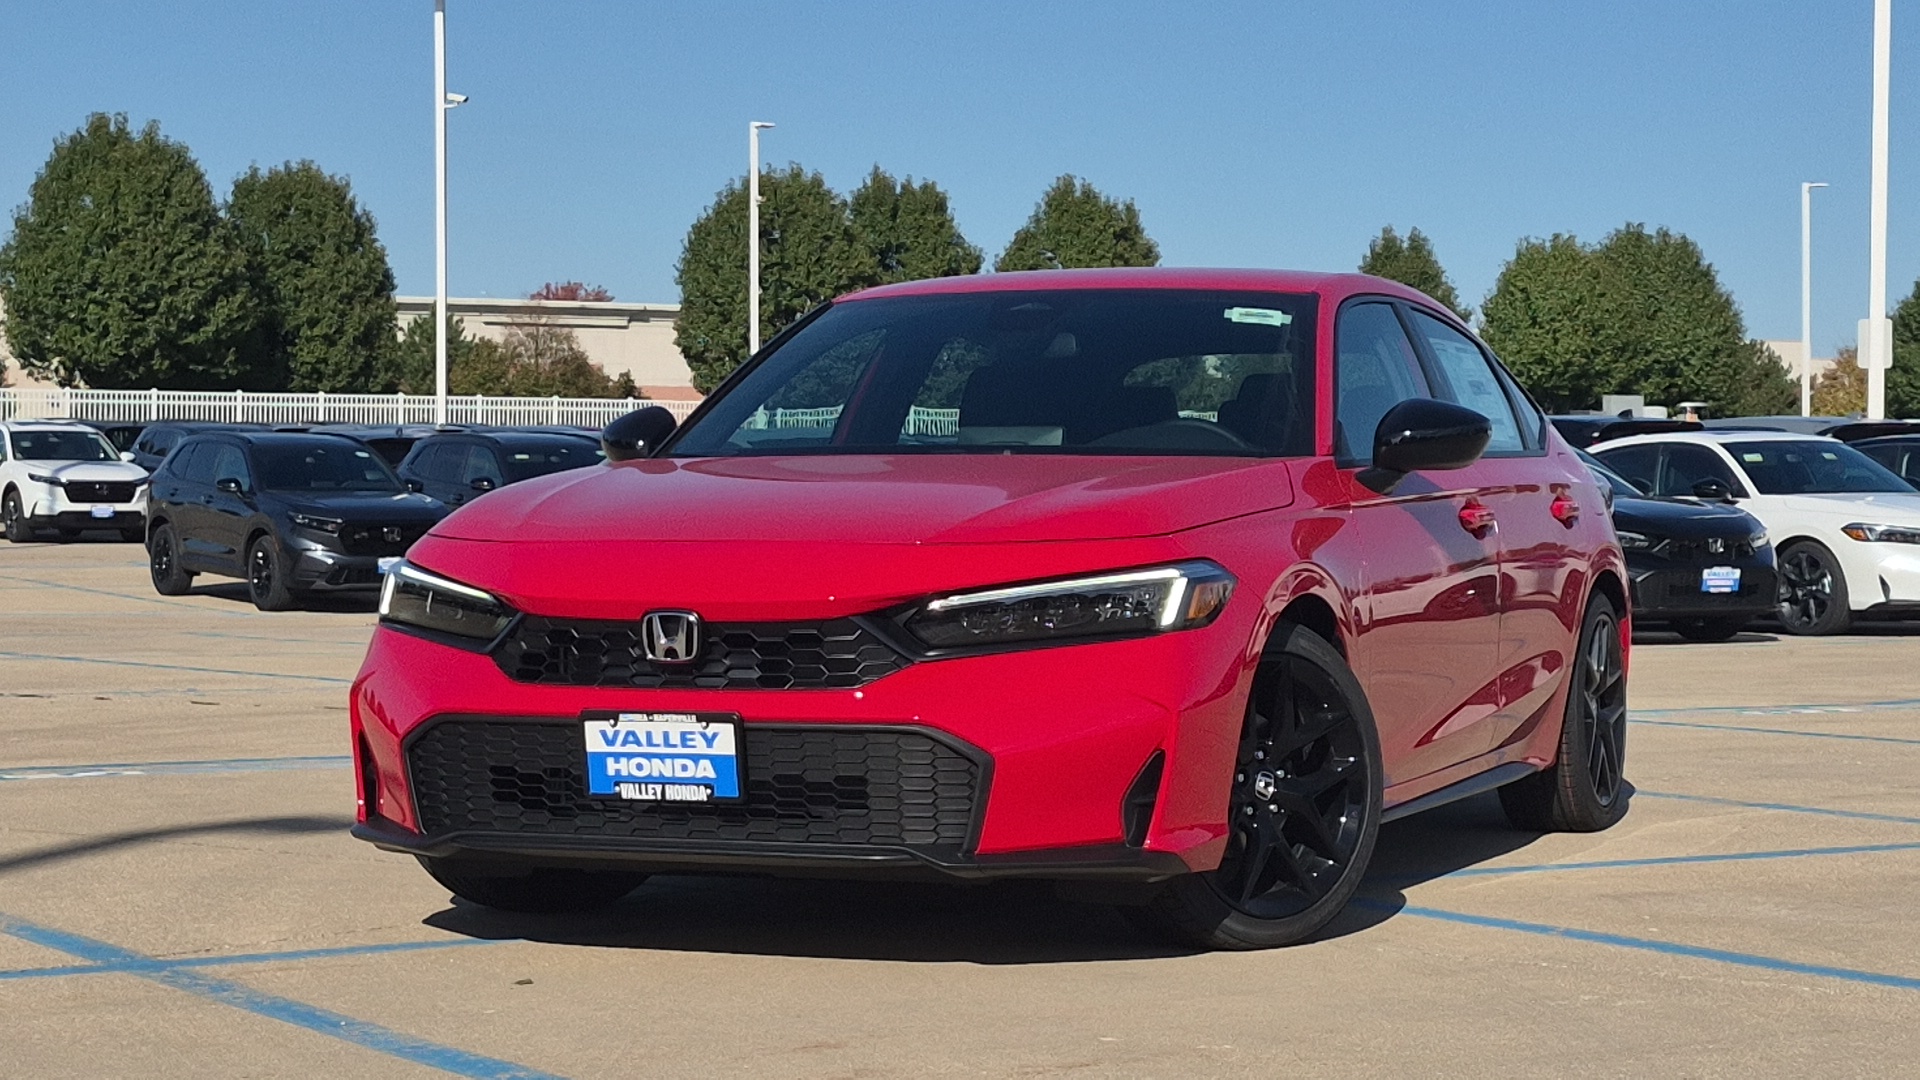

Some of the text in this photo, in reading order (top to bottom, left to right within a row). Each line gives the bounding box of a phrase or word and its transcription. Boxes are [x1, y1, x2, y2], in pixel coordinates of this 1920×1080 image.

[599, 730, 719, 749] VALLEY
[606, 757, 717, 778] HONDA
[619, 782, 708, 801] VALLEY HONDA
